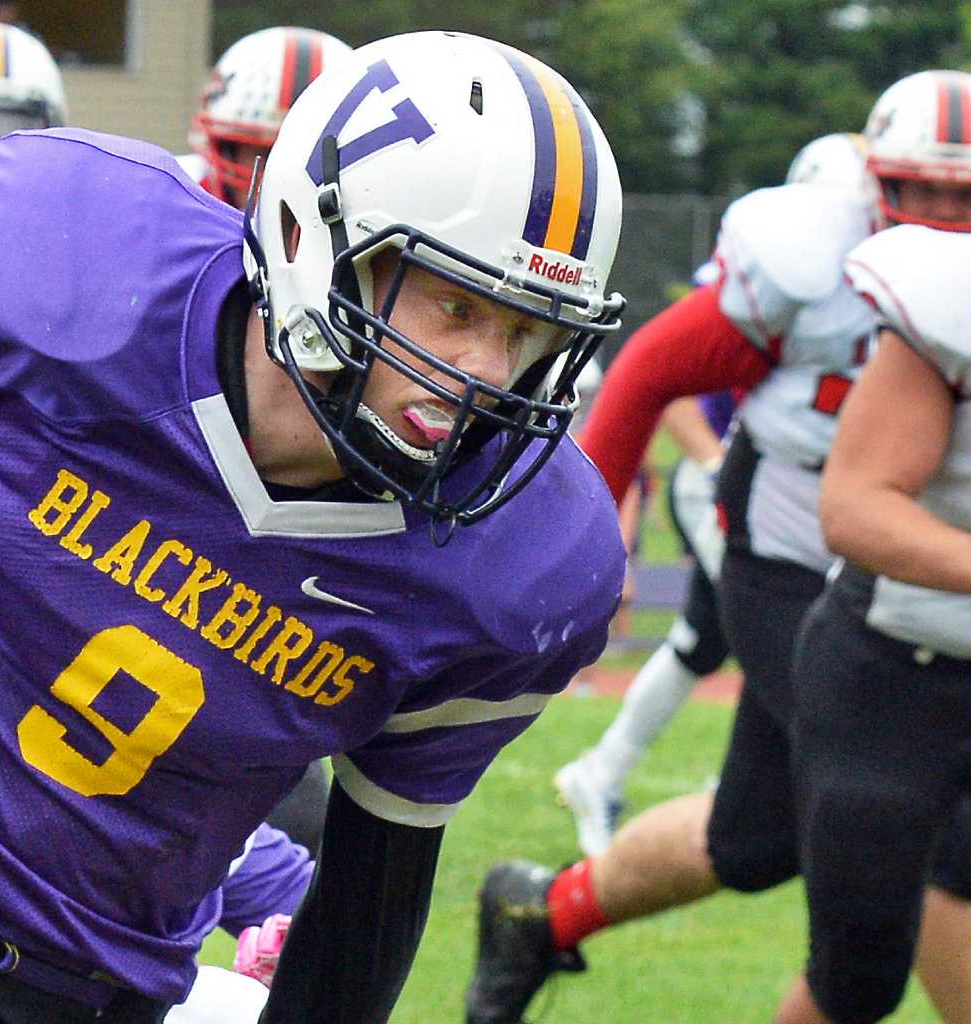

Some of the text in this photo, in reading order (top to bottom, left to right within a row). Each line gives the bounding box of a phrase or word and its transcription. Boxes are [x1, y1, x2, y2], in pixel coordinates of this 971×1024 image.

[305, 58, 436, 188] V
[528, 253, 582, 286] Riddell
[28, 468, 375, 707] BLACKBIRDS
[17, 624, 206, 797] 9
